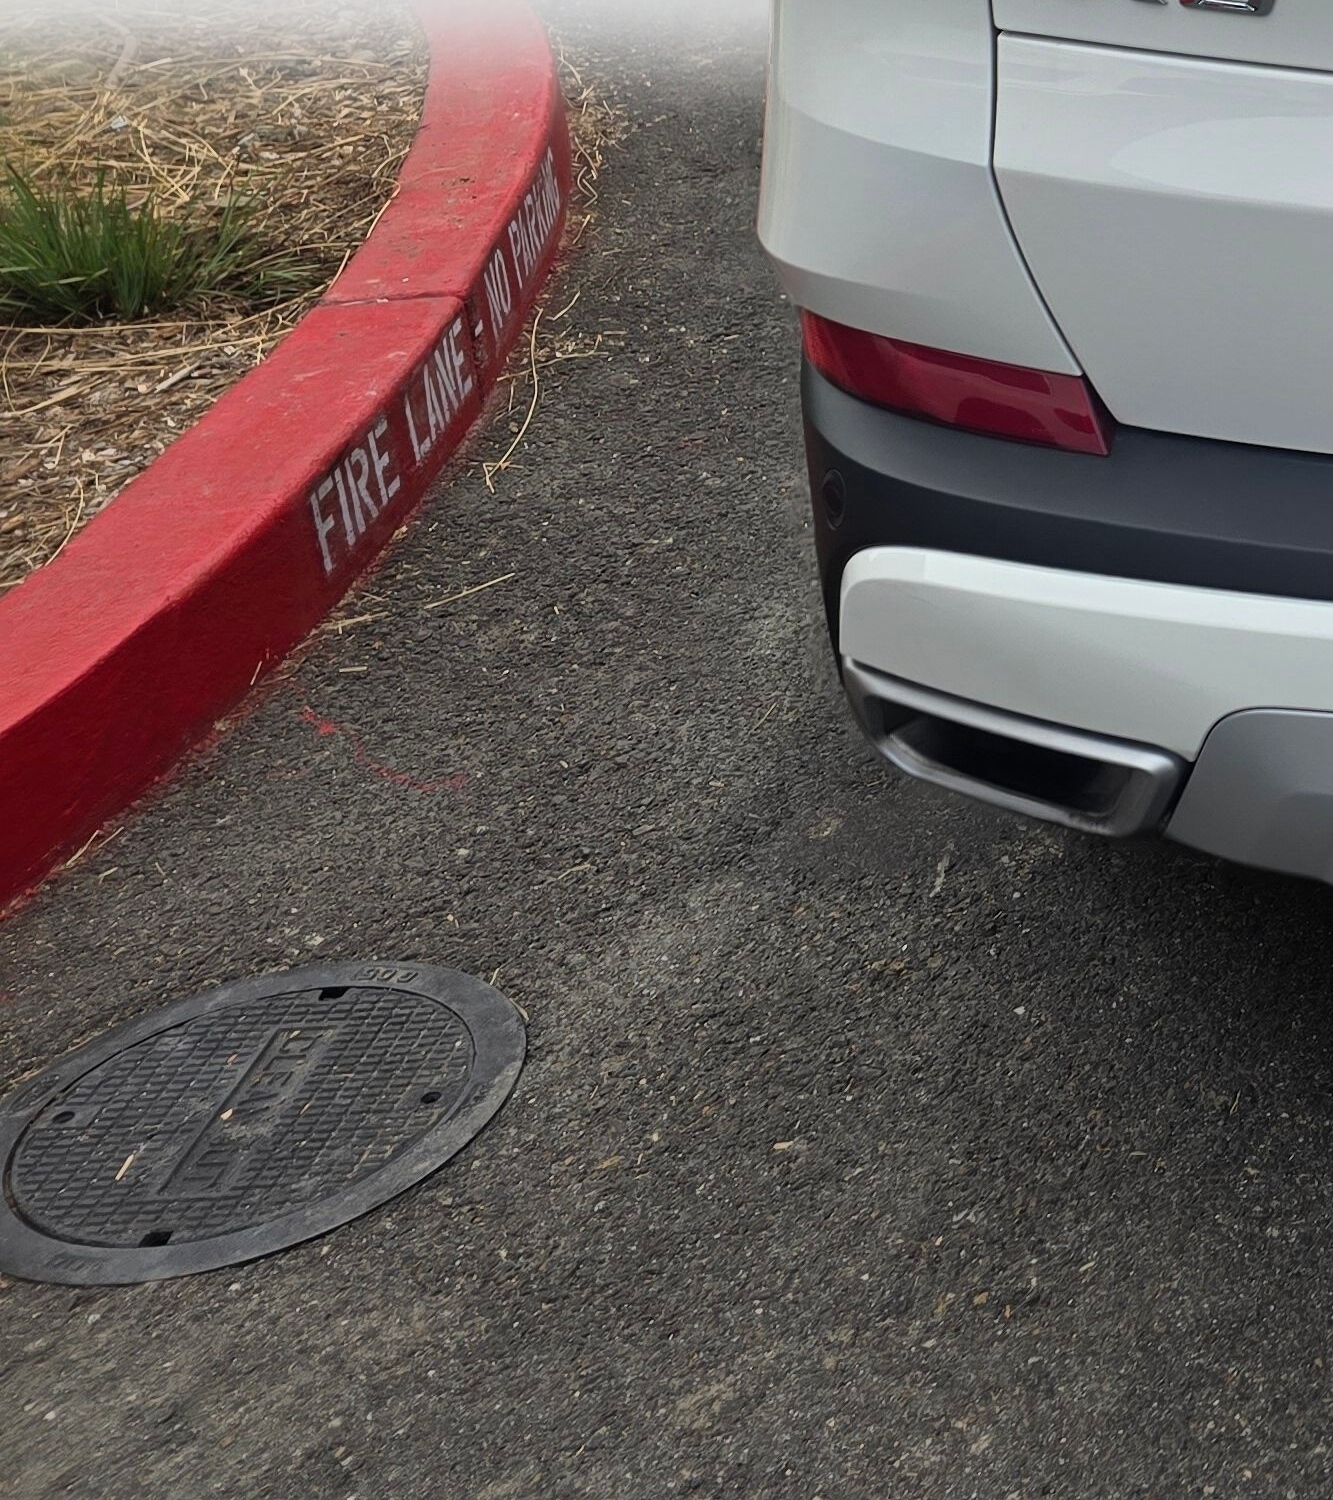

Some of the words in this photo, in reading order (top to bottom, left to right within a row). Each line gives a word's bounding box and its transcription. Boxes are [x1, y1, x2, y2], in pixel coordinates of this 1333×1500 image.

[309, 415, 401, 576] FIRE
[403, 316, 475, 467] LANE
[483, 247, 512, 348] NO
[507, 145, 561, 290] PARKING
[181, 1033, 323, 1189] CLEANUT
